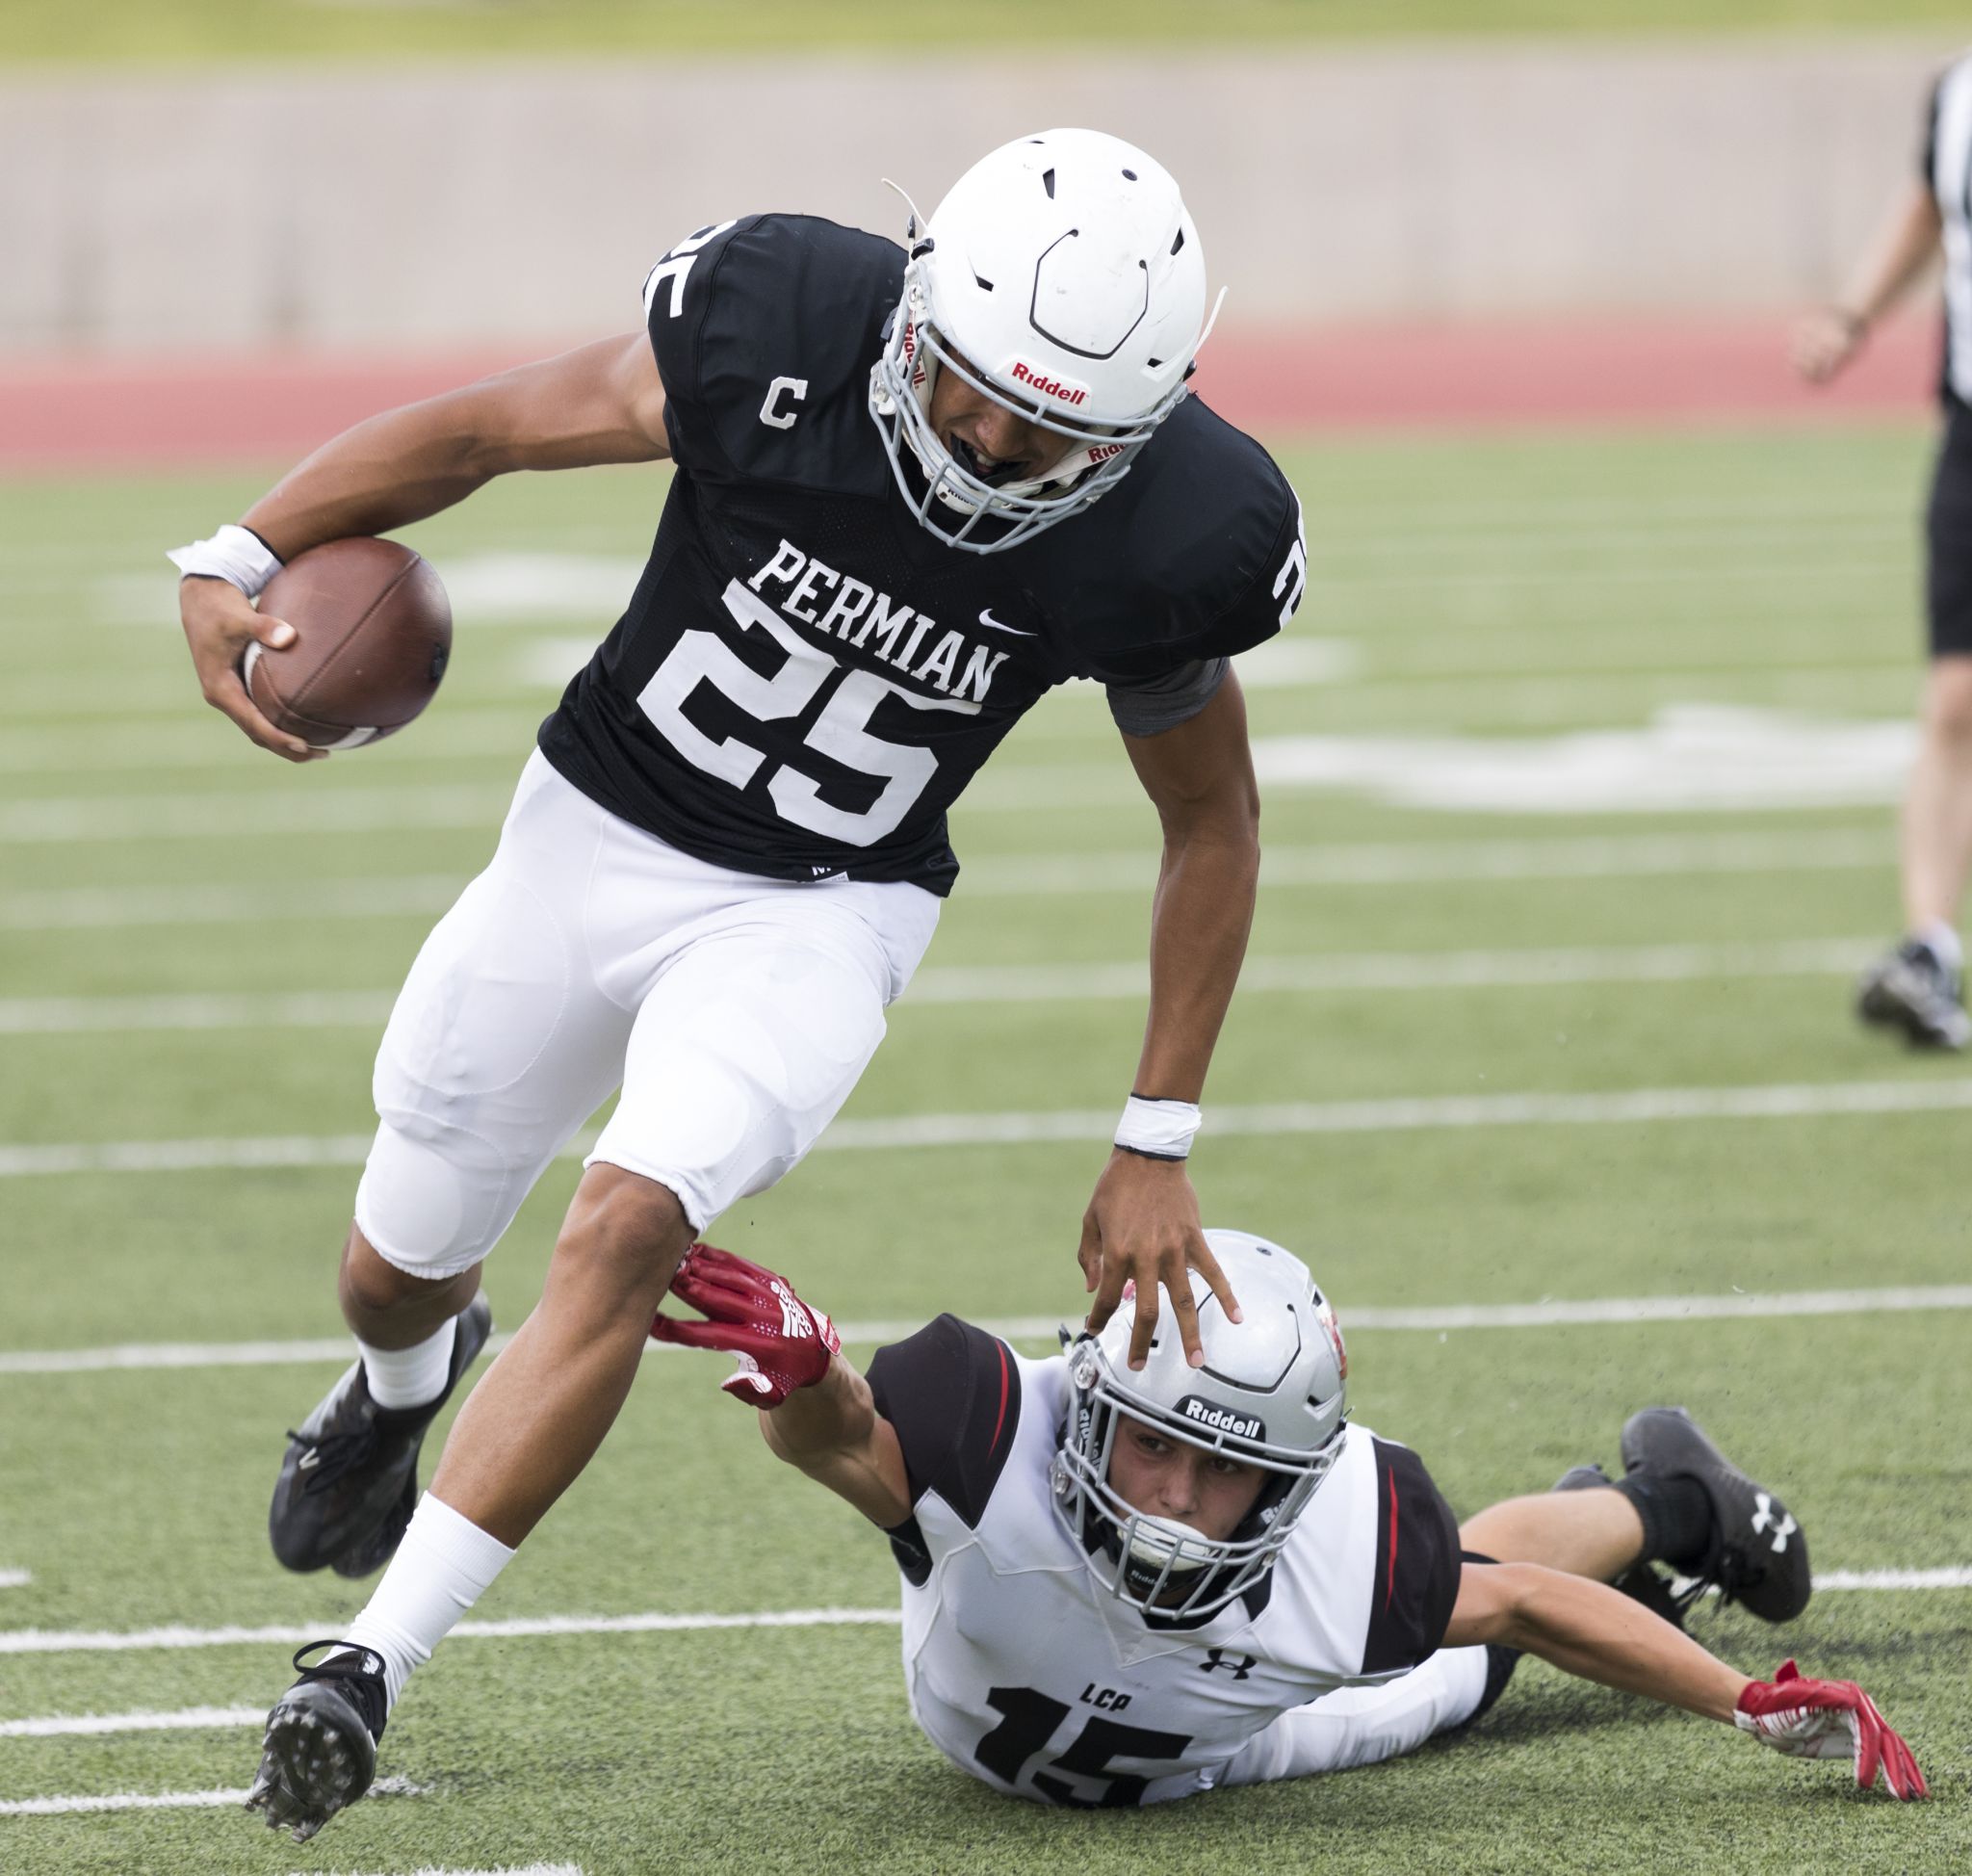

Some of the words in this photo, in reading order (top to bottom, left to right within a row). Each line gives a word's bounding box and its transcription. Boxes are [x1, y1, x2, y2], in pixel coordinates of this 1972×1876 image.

[760, 377, 808, 430] C
[1012, 362, 1085, 405] Riddell
[747, 538, 1011, 703] PERMIAN
[636, 577, 983, 847] 25
[1185, 1398, 1260, 1438] Riddell
[1079, 1683, 1132, 1711] LCP
[973, 1686, 1194, 1809] 15
